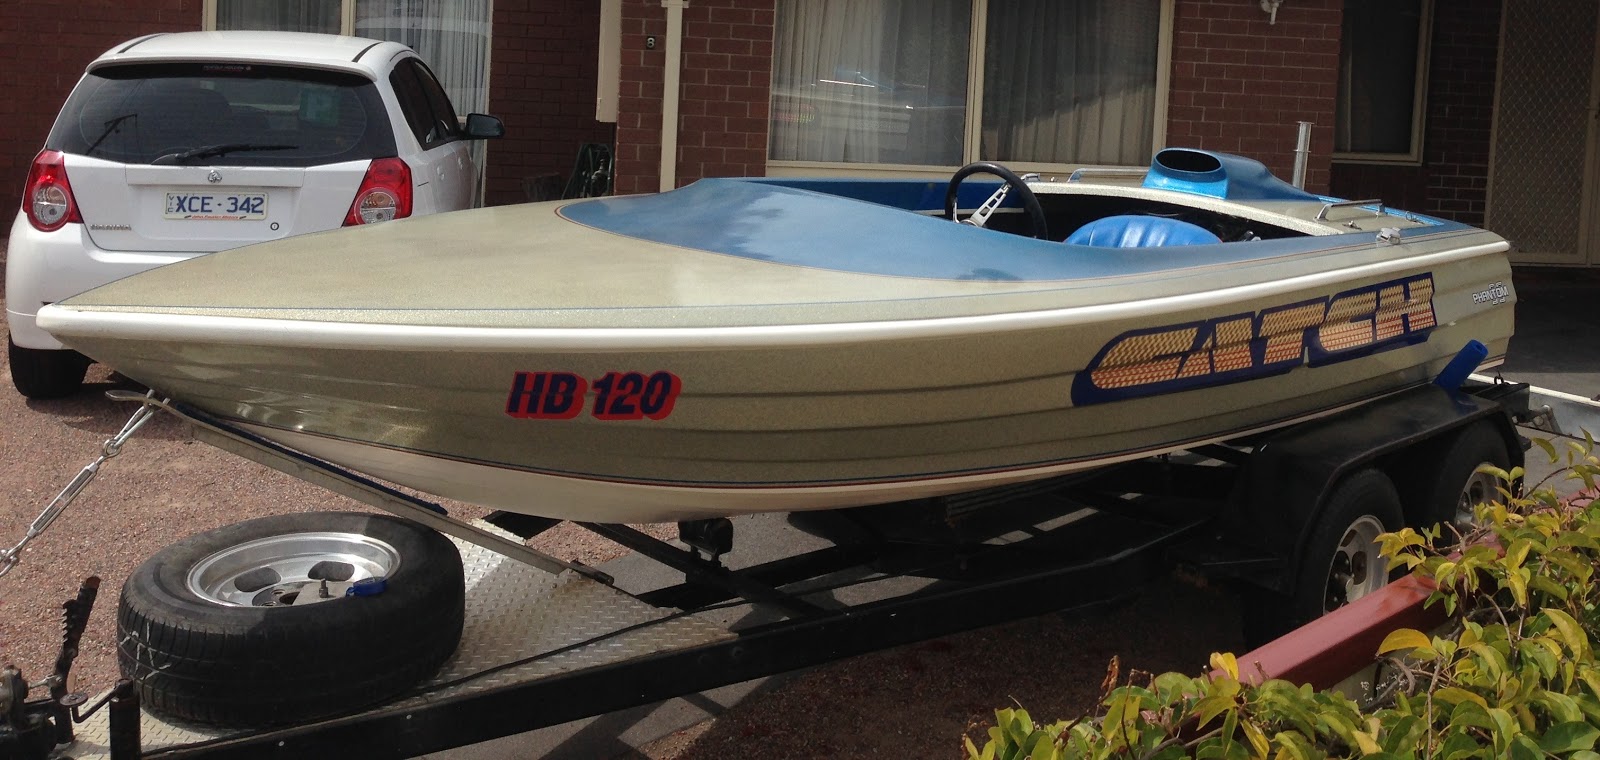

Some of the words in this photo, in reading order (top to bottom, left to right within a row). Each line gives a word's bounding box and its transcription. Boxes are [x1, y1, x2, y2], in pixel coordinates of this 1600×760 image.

[647, 37, 655, 48] 8
[1472, 285, 1509, 304] PHANTOM
[1076, 273, 1438, 400] CATCH
[505, 371, 586, 419] HB
[592, 370, 682, 420] 120
